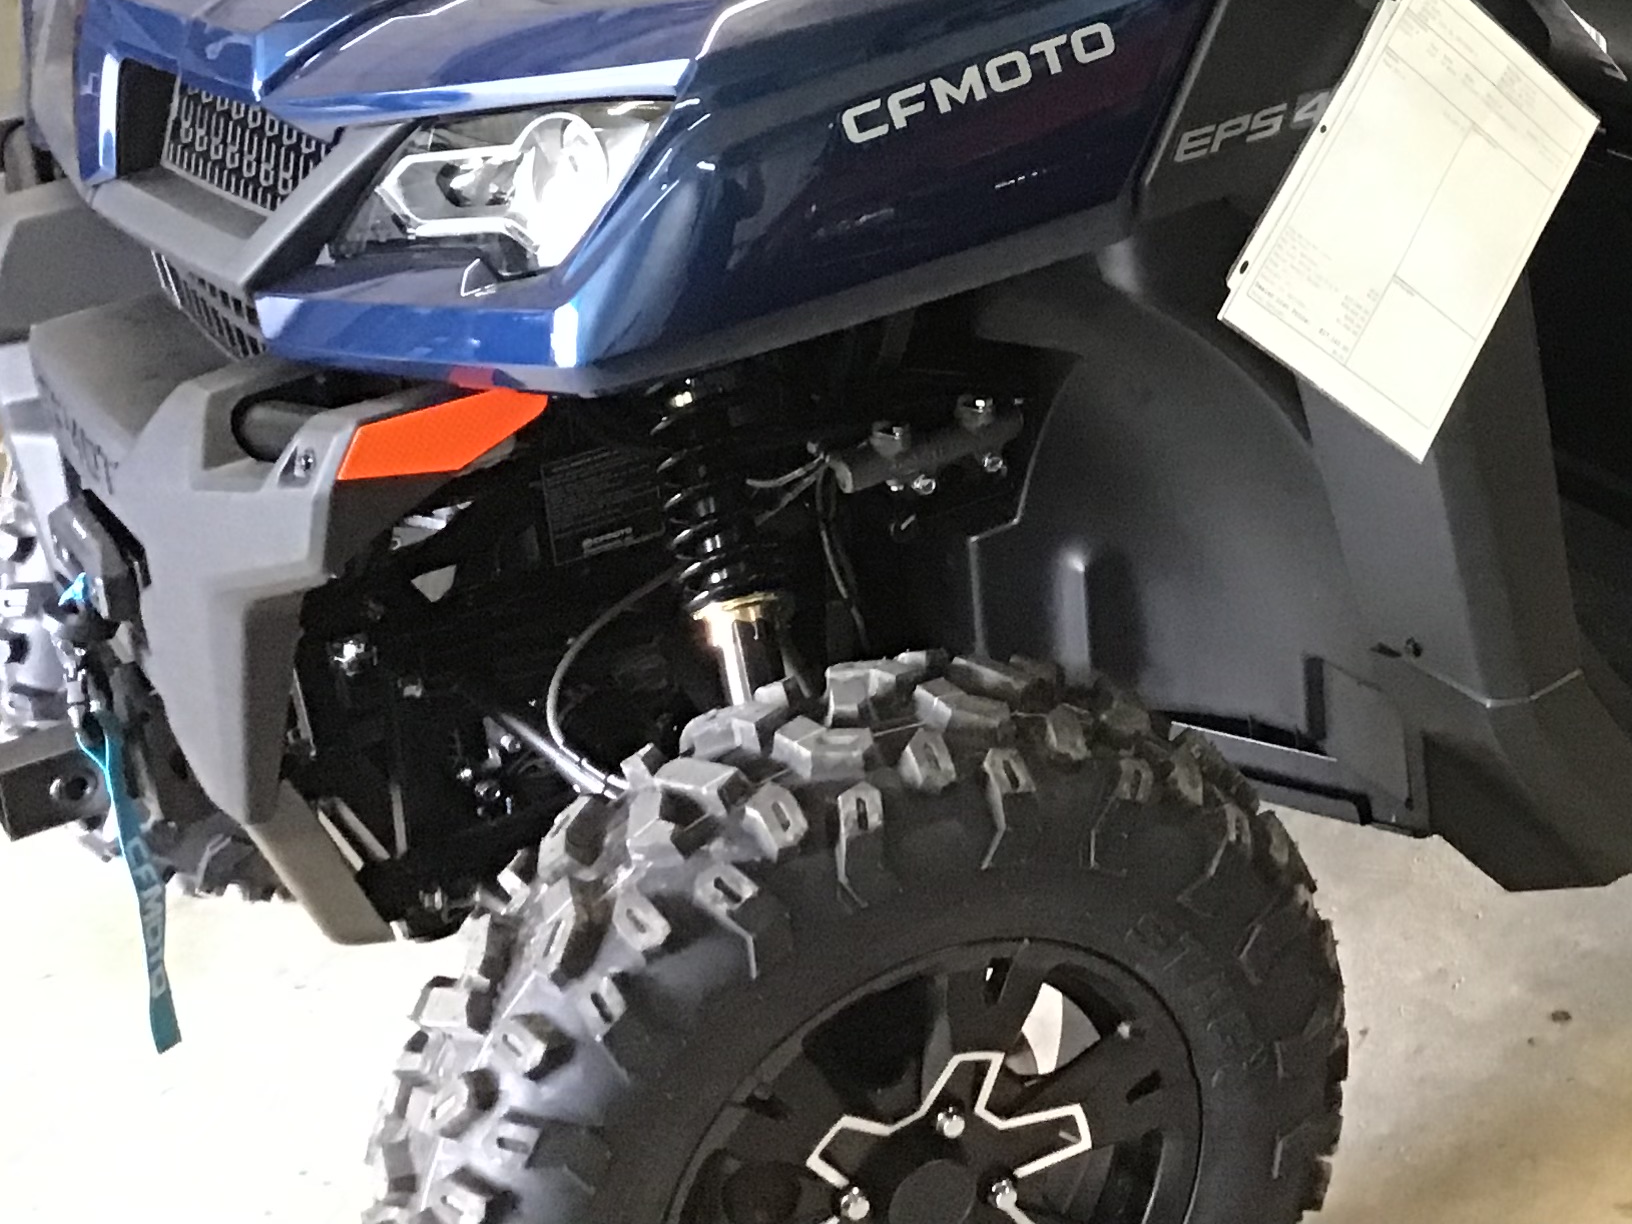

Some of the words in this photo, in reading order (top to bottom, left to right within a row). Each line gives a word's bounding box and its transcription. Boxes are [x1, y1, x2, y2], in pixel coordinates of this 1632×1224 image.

[841, 22, 1115, 143] CFMOTO
[1172, 102, 1288, 162] EPS
[125, 836, 167, 998] CFMOTO
